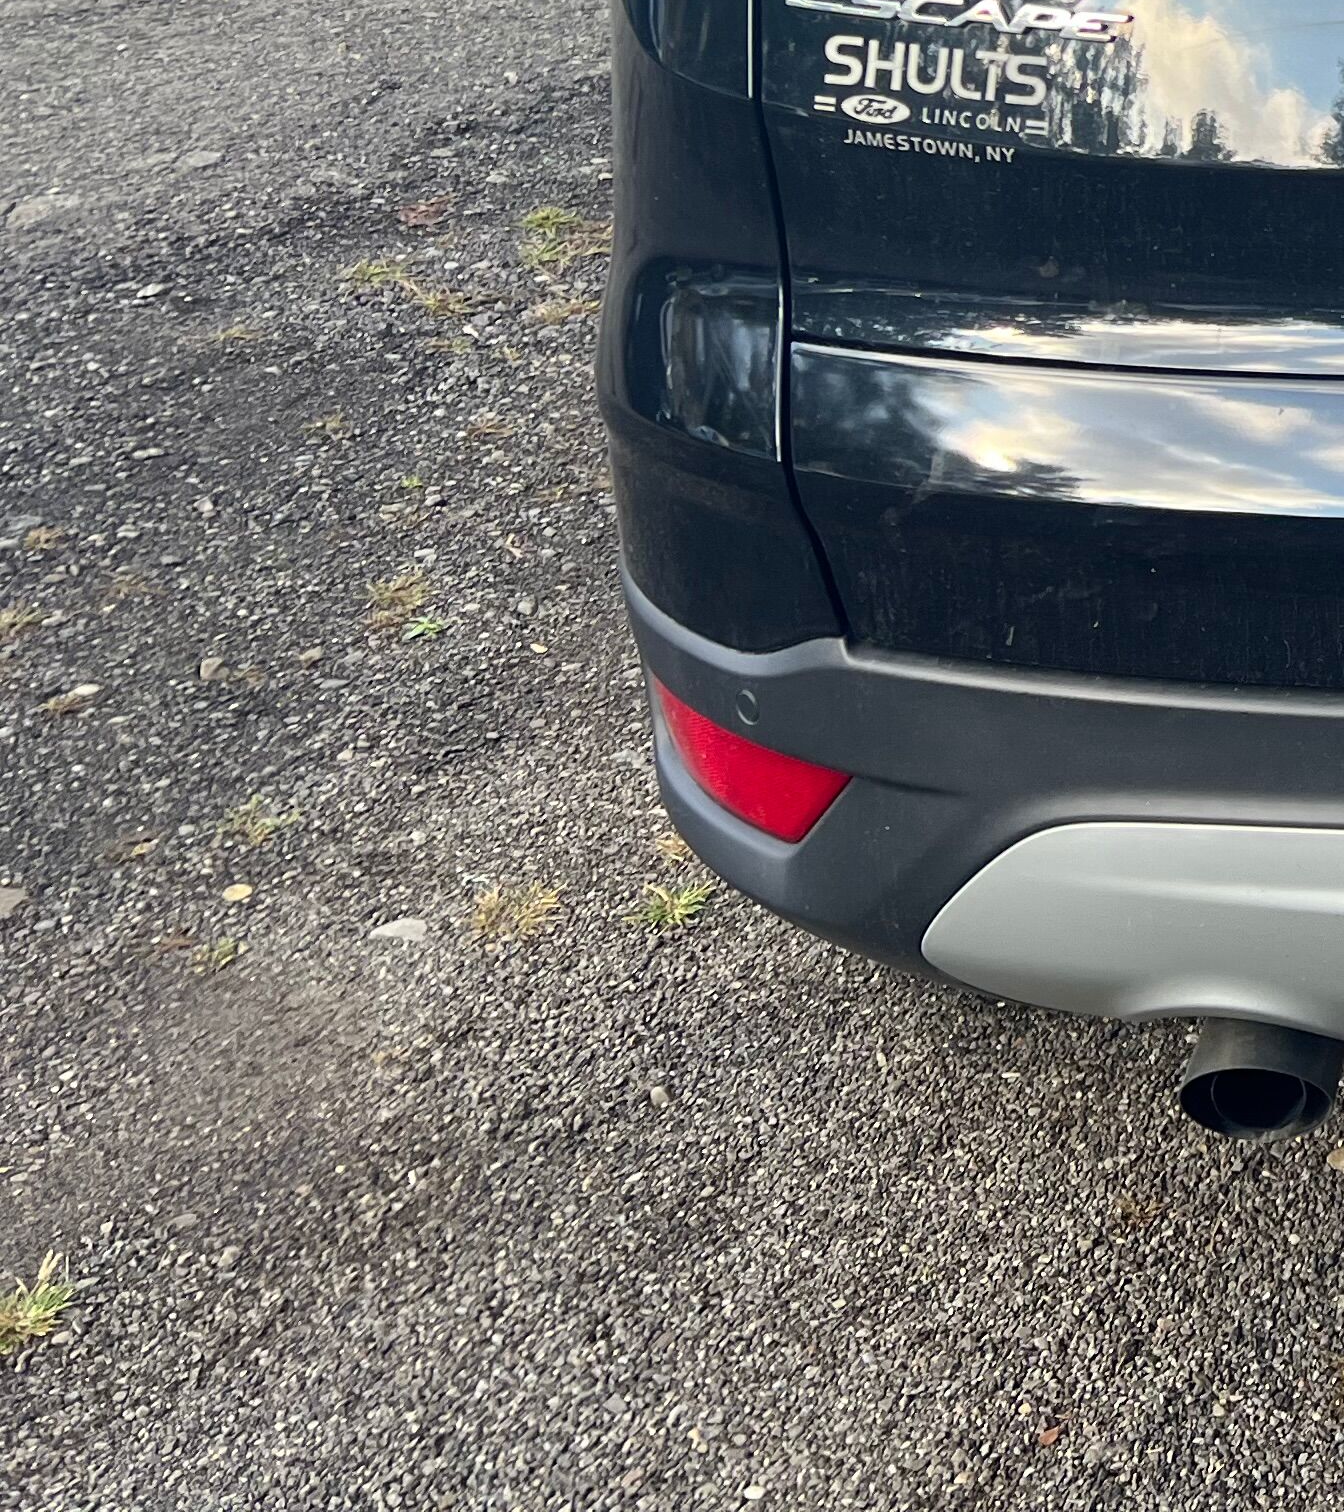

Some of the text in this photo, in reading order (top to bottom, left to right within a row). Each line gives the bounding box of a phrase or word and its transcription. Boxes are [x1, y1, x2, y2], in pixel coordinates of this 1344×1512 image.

[824, 35, 1048, 106] SHULTS
[853, 98, 1021, 134] Ford LINCOLN
[844, 129, 1015, 164] JAMESTOWN, NY
